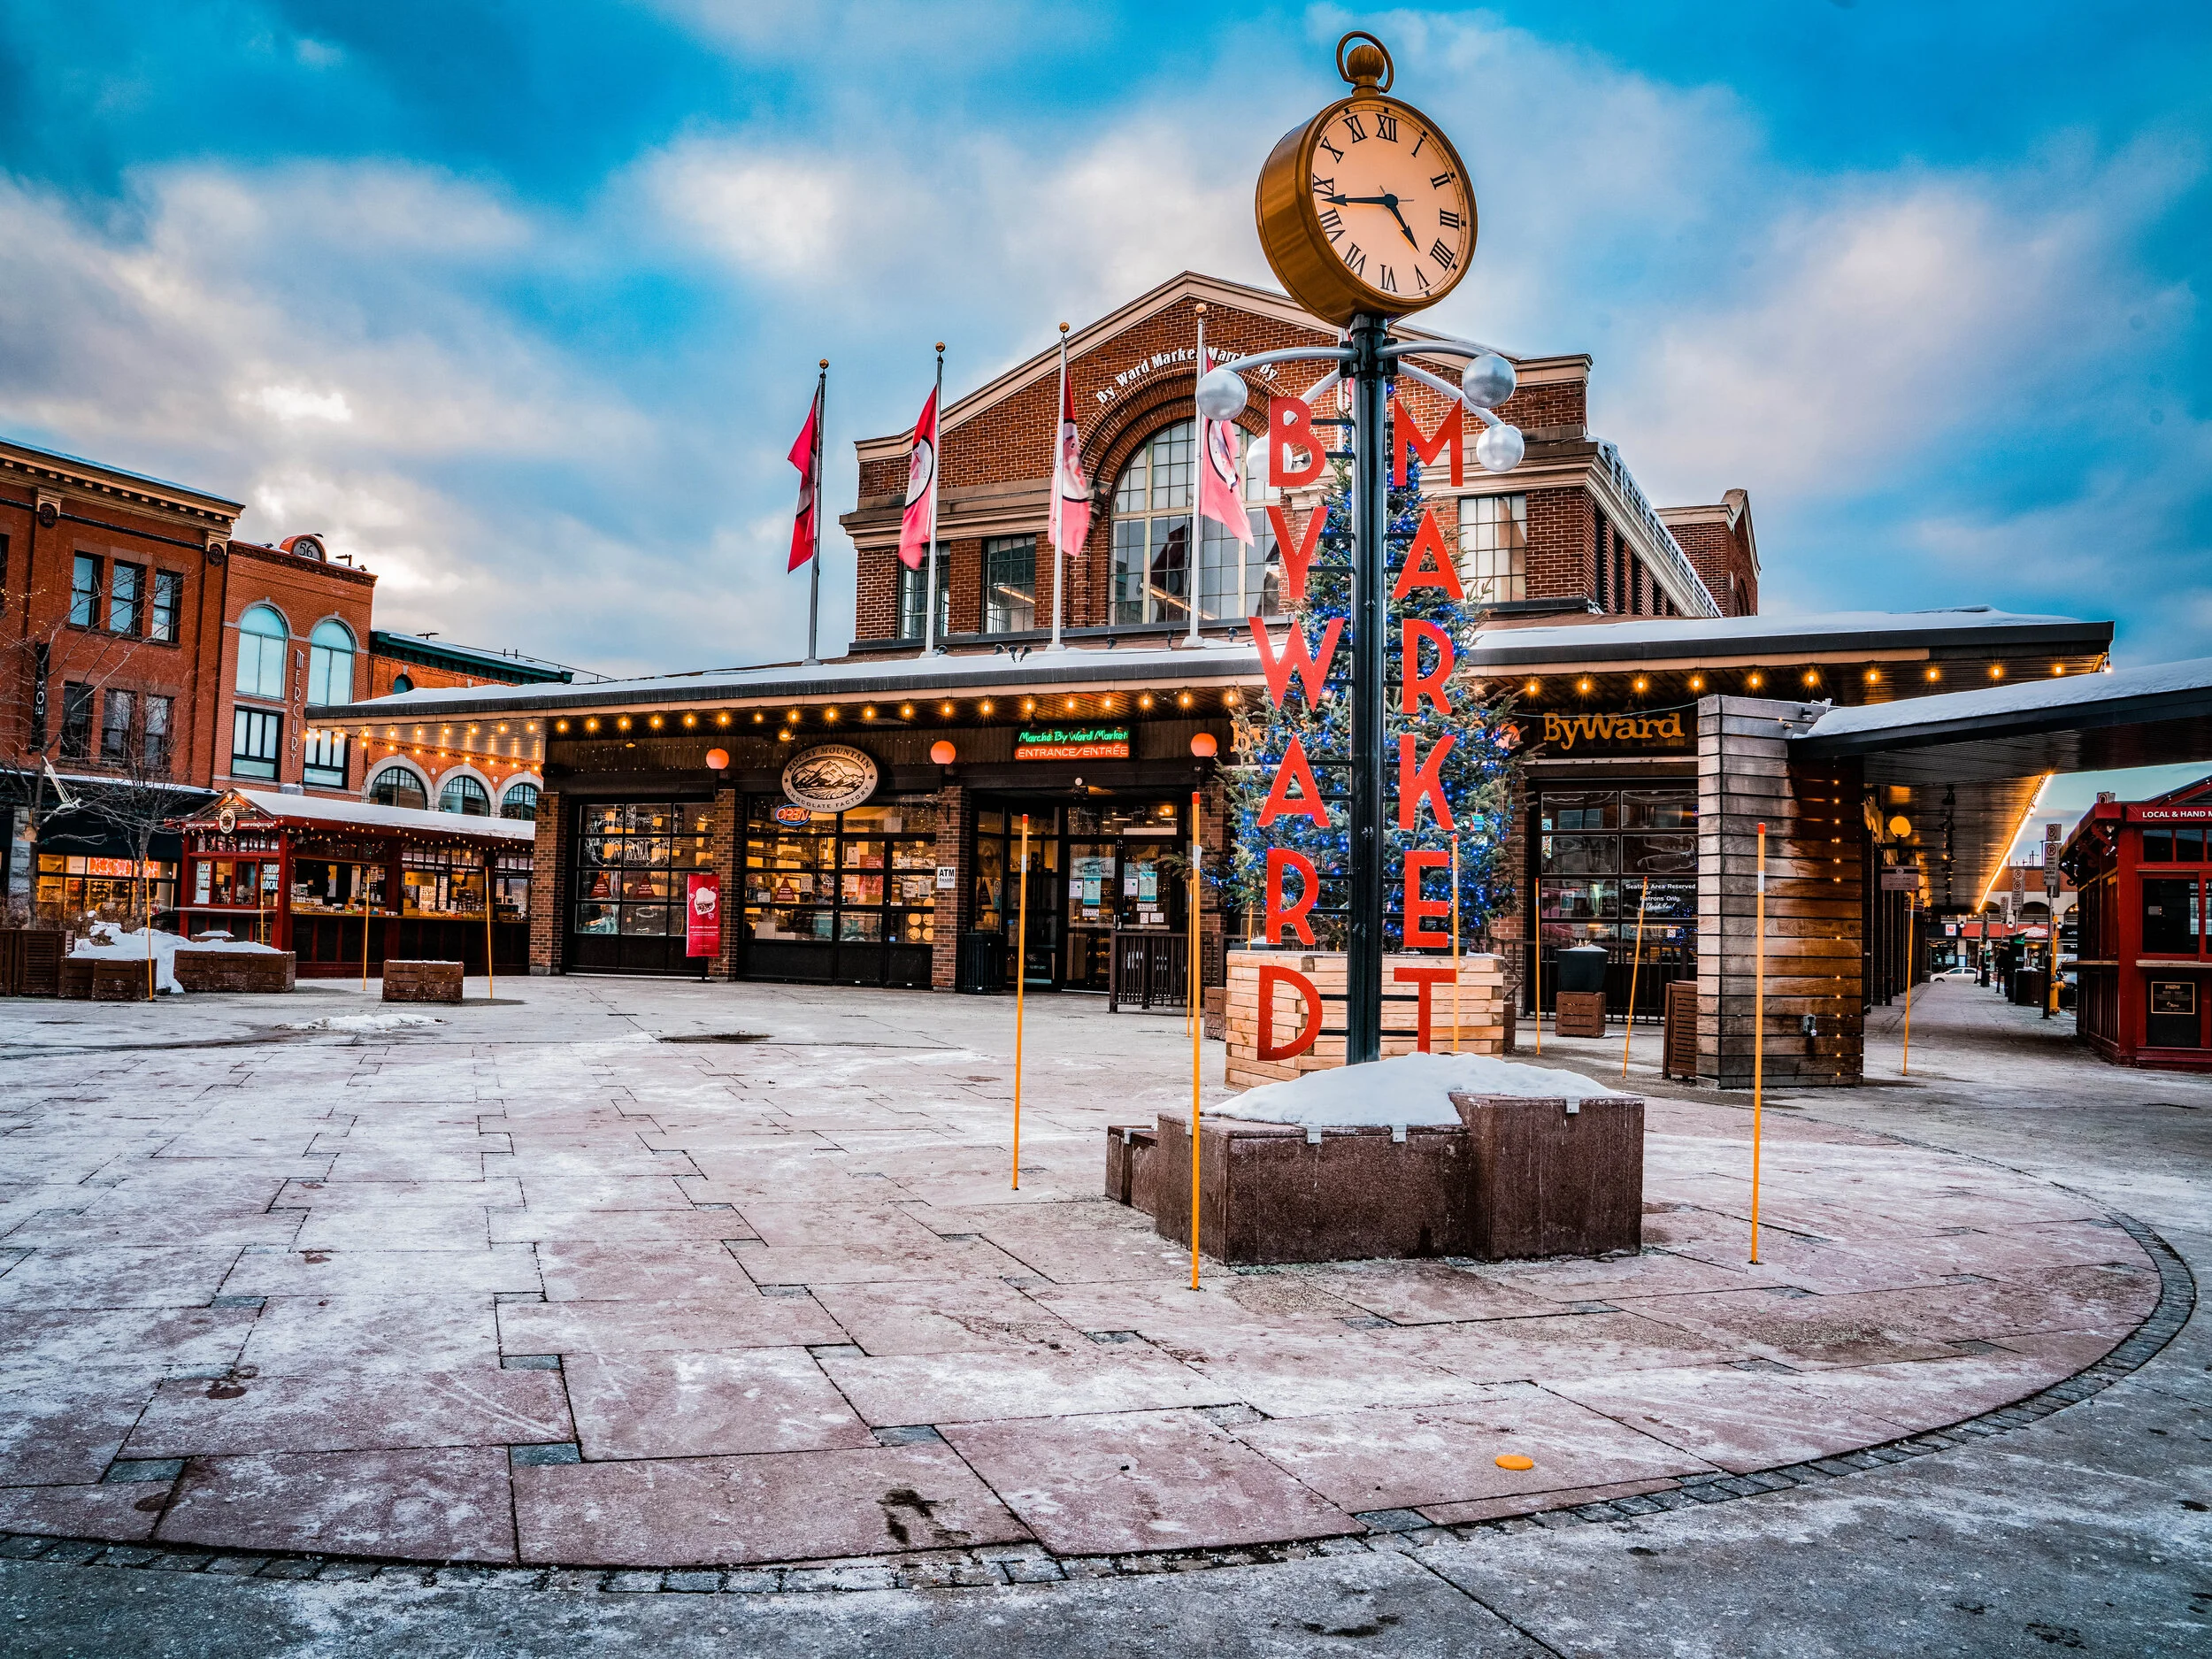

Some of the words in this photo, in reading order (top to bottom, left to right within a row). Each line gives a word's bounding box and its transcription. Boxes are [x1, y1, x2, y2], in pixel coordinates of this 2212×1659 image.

[1342, 114, 1368, 143] XI
[1375, 113, 1398, 143] XII
[1319, 135, 1344, 164] X
[1411, 136, 1425, 158] I
[1312, 173, 1334, 196] IX
[1430, 171, 1451, 190] II
[1440, 208, 1460, 231] III
[1429, 237, 1455, 271] IIII
[1379, 264, 1398, 293] VI
[1414, 264, 1430, 290] V
[1095, 386, 1116, 404] By
[1115, 359, 1150, 387] Ward
[1151, 348, 1198, 369] Marke
[299, 542, 313, 557] 56
[290, 649, 305, 768] MERCURY
[1054, 731, 1068, 744] By
[1069, 730, 1094, 741] Ward
[1094, 729, 1128, 741] Market
[1543, 712, 1686, 750] ByWard
[787, 749, 818, 772] ROCKY
[820, 747, 872, 769] MOUNTAIN
[787, 787, 832, 809] CHOCOLATE
[835, 786, 870, 808] FACTORY
[776, 808, 810, 821] OPEN
